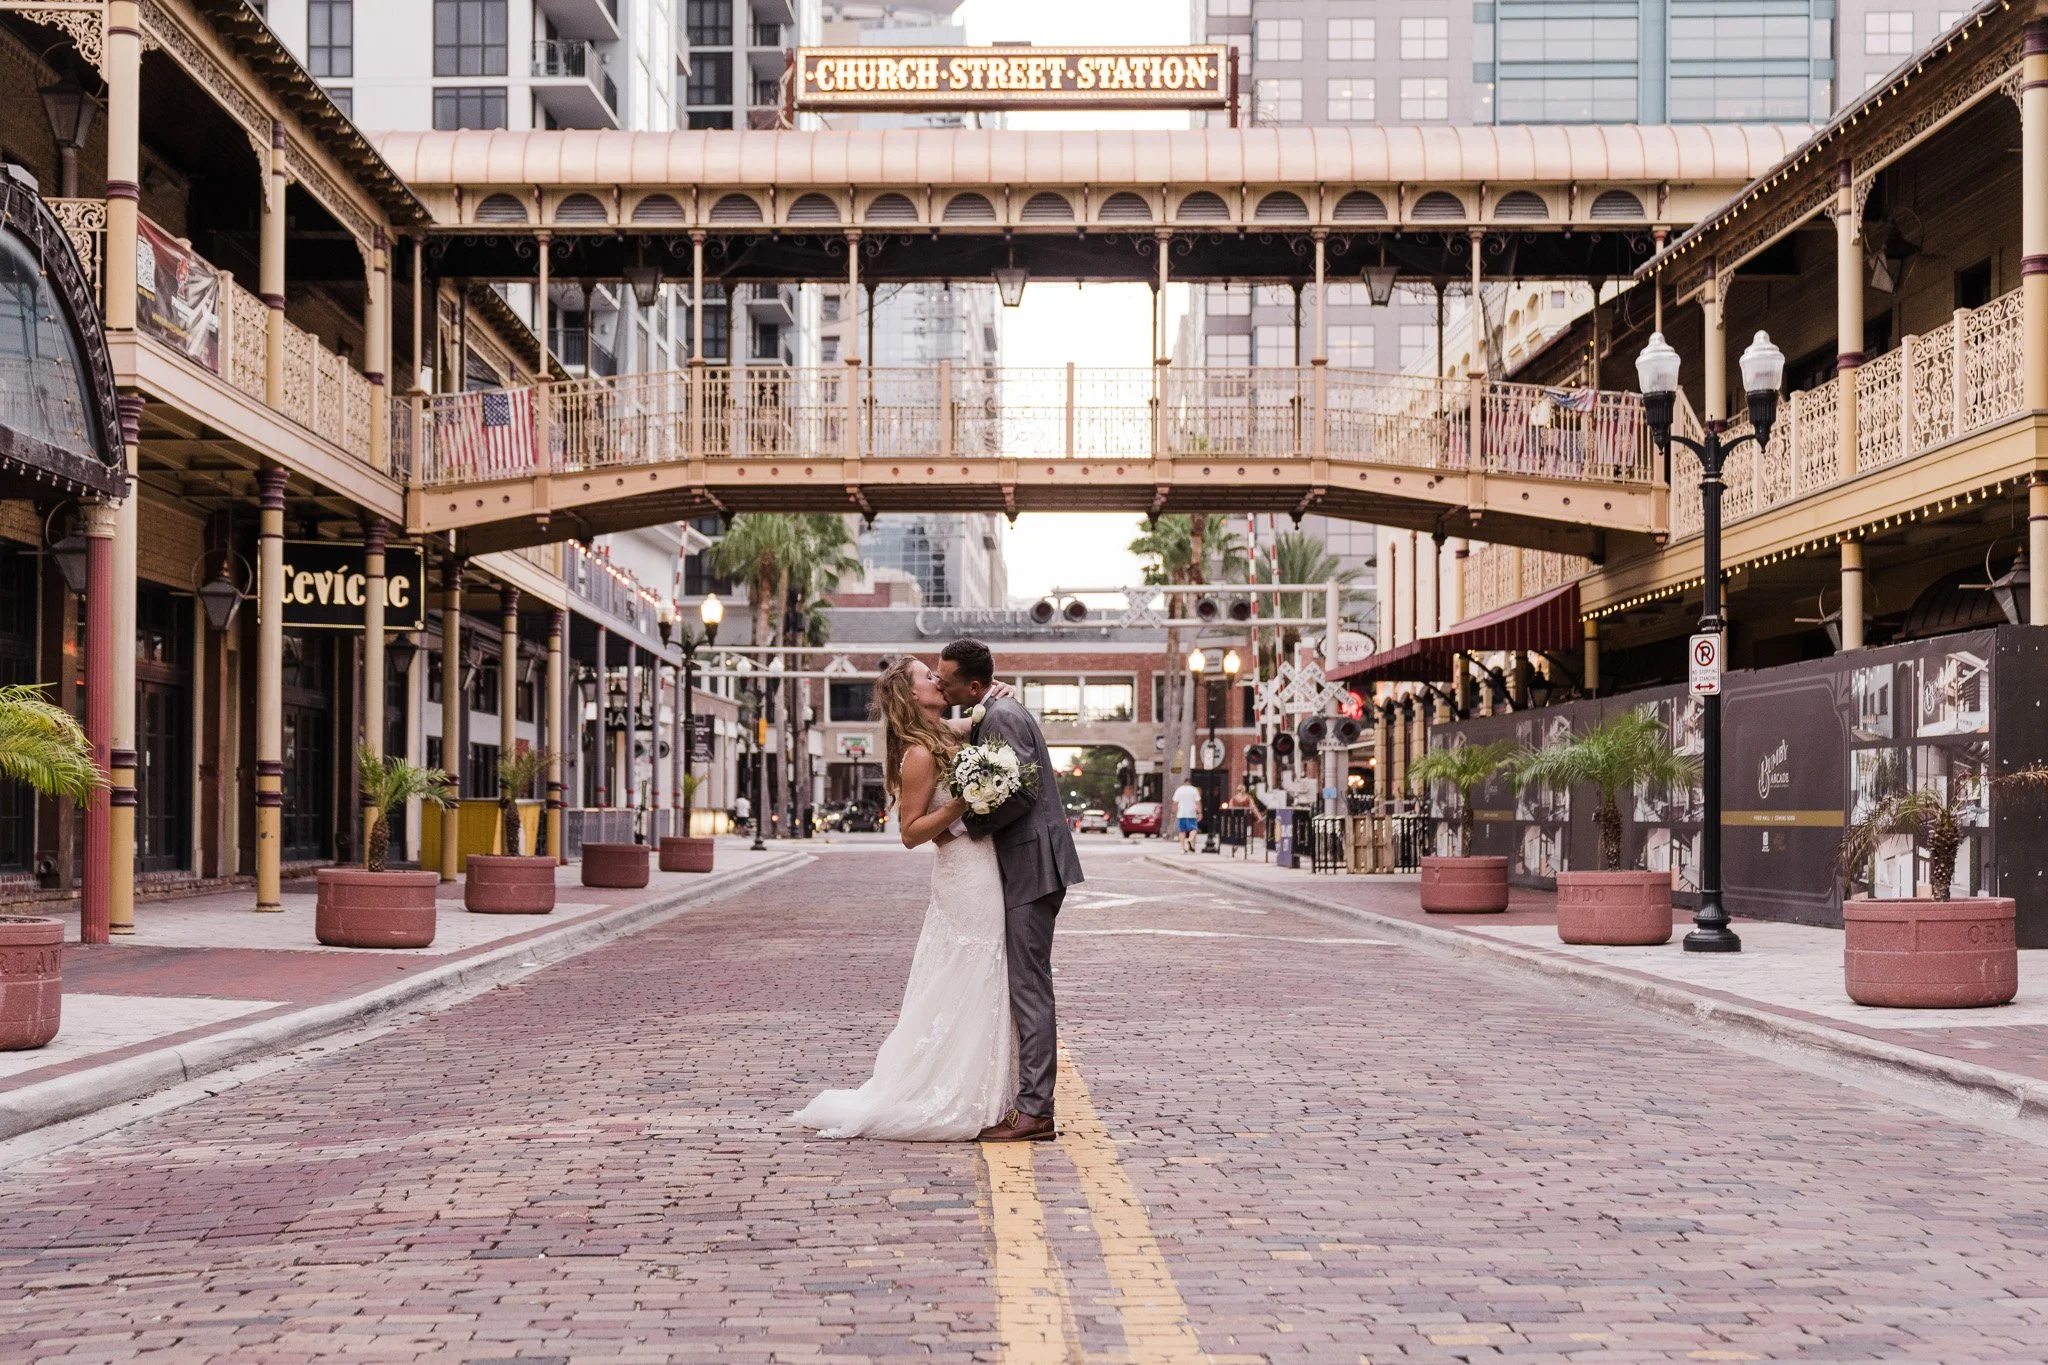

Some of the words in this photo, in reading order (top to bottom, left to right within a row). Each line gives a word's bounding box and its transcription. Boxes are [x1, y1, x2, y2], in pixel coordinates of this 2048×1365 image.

[815, 59, 940, 92] CHURCH
[948, 57, 1067, 90] STREET
[1076, 55, 1209, 89] STATION
